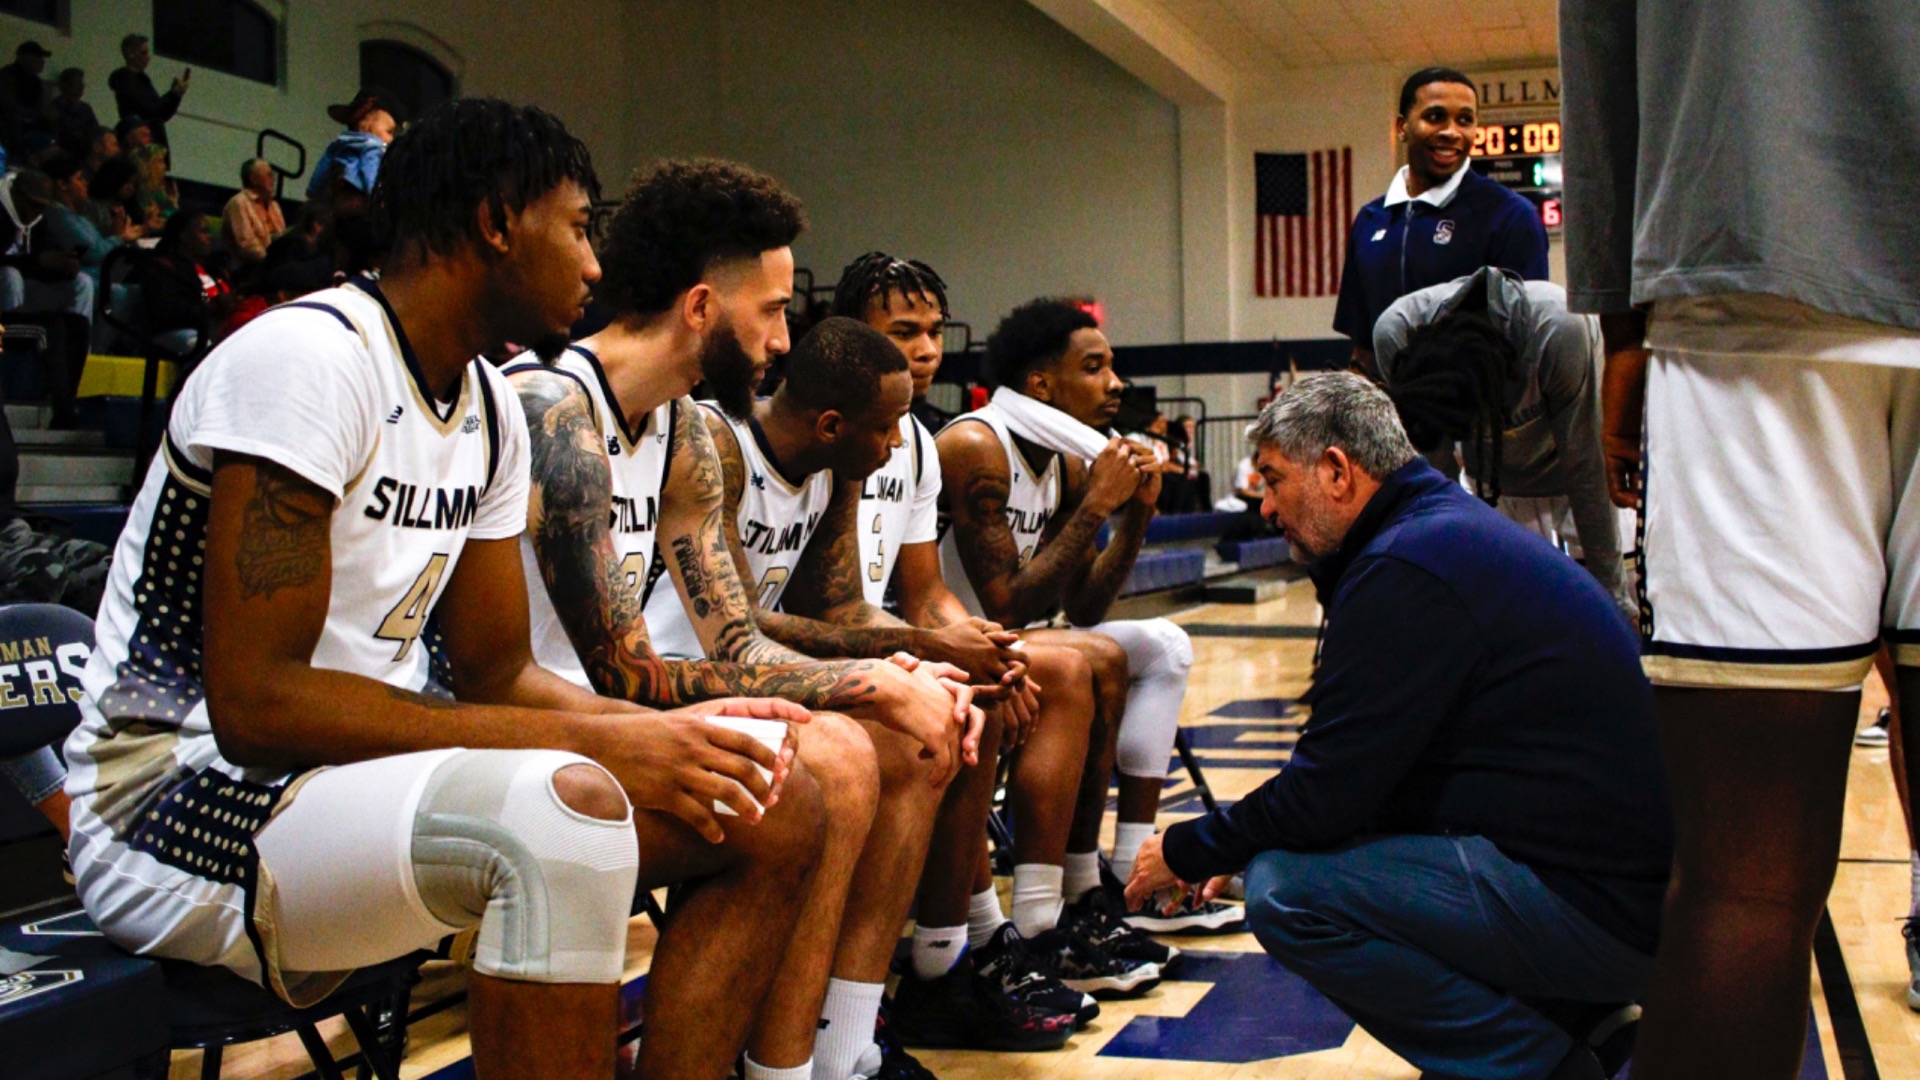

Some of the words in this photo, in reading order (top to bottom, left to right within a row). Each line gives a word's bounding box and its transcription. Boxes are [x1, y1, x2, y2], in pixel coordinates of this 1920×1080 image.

[1469, 122, 1561, 156] 20:00
[1542, 199, 1561, 227] 6
[373, 552, 449, 662] 4
